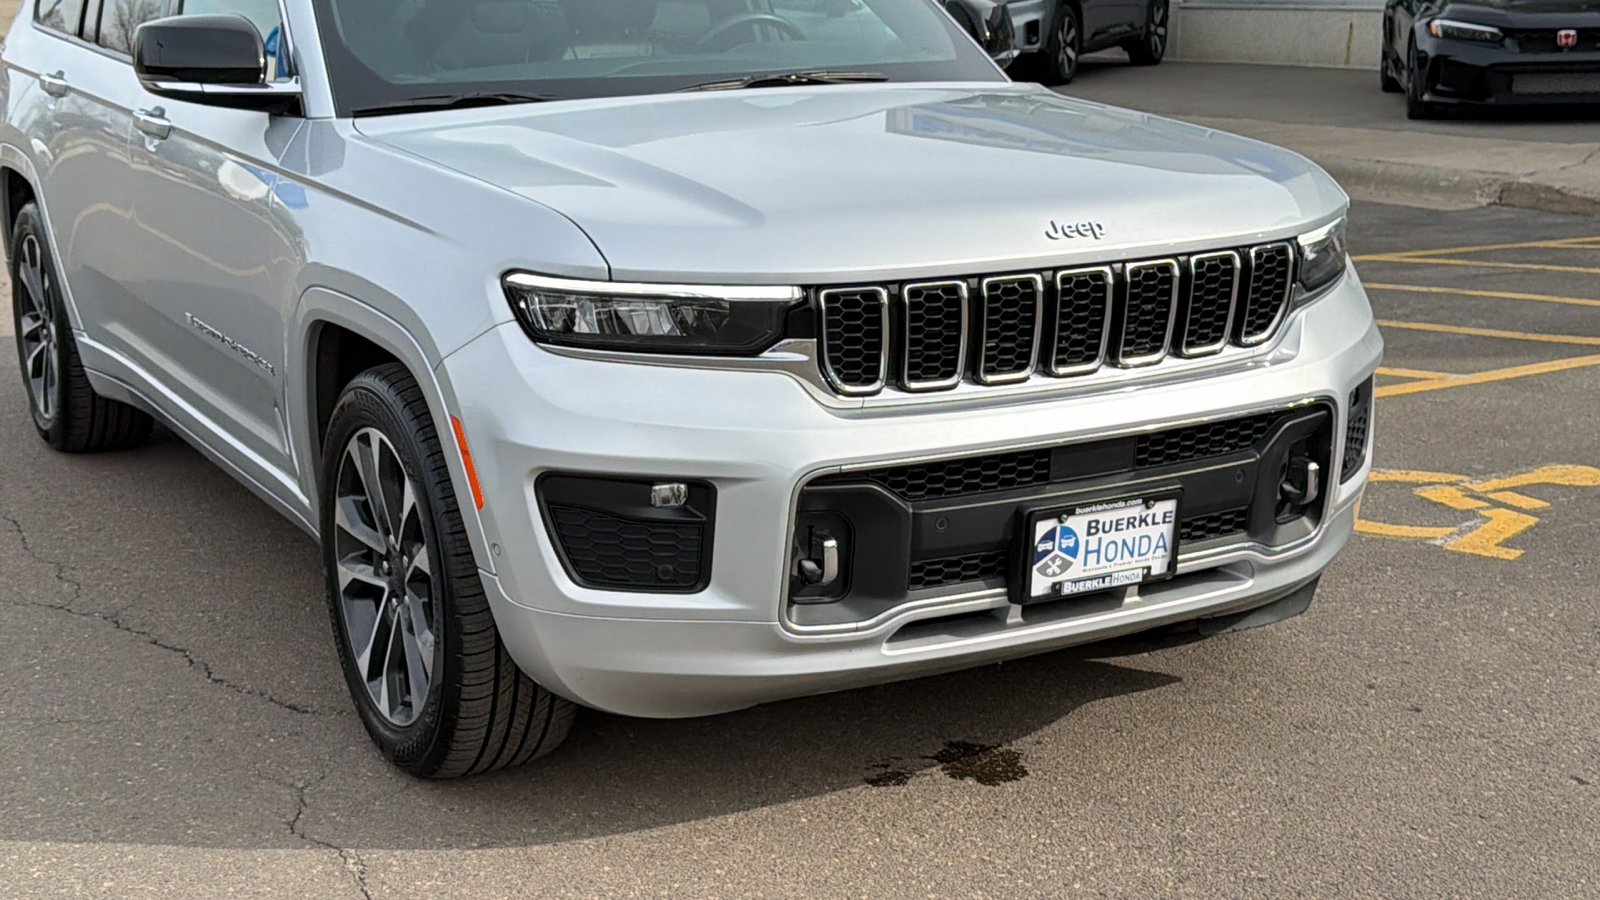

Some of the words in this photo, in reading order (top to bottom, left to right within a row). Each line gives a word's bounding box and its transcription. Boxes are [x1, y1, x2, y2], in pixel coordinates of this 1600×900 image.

[1045, 220, 1106, 240] Jeep
[1075, 499, 1143, 514] buerklehonda.com
[1086, 510, 1173, 537] BUERKLE
[1083, 531, 1168, 567] HONDA
[1063, 576, 1112, 593] BUERKLE
[1113, 572, 1140, 584] HONDA
